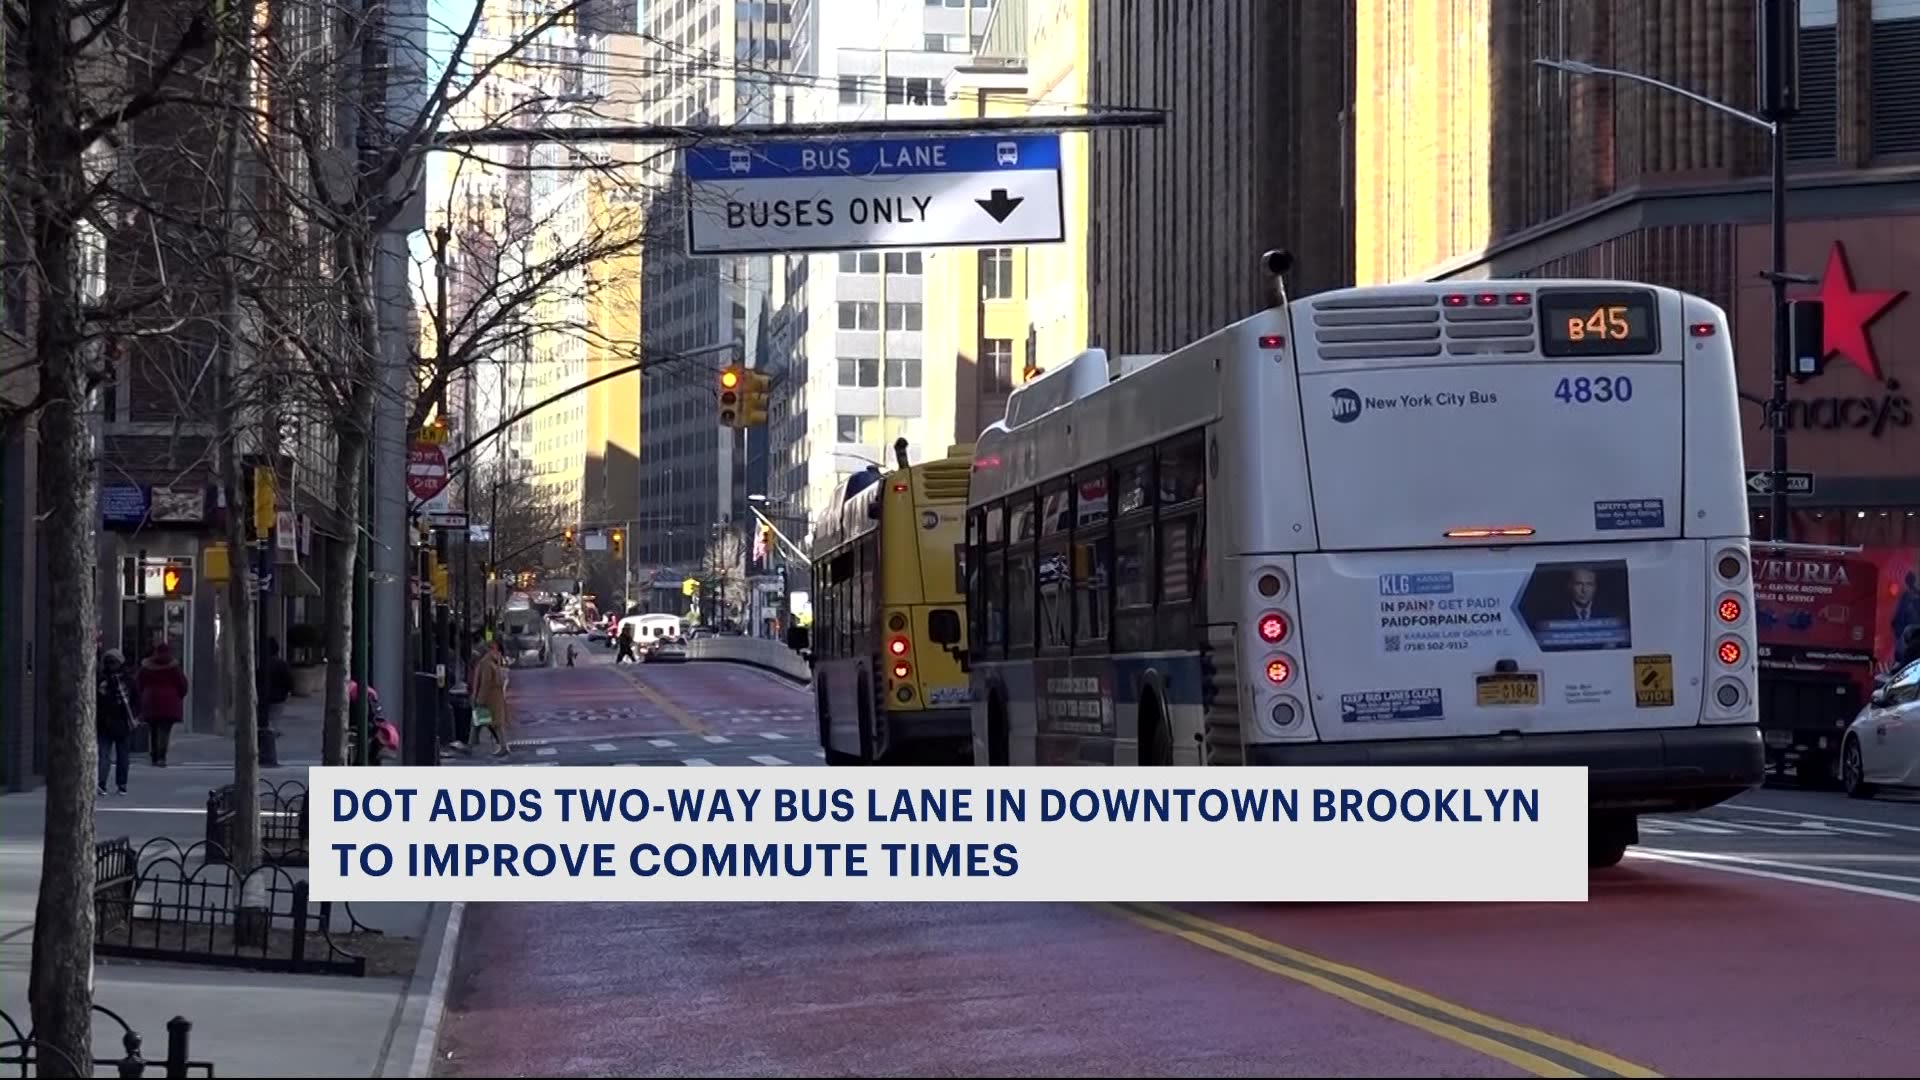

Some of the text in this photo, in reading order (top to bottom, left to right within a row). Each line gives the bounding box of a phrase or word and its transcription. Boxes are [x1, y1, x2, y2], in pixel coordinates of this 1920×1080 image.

[803, 145, 946, 170] BUS LANE
[727, 196, 932, 228] BUSES ONLY
[1569, 307, 1630, 340] B45
[1365, 391, 1497, 409] New York City Bus
[1555, 376, 1632, 403] 4830
[1382, 575, 1409, 594] KLG
[1381, 597, 1500, 612] IN PAIN? GET PAID!
[1381, 612, 1501, 627] PAIDFORPAIN.COM
